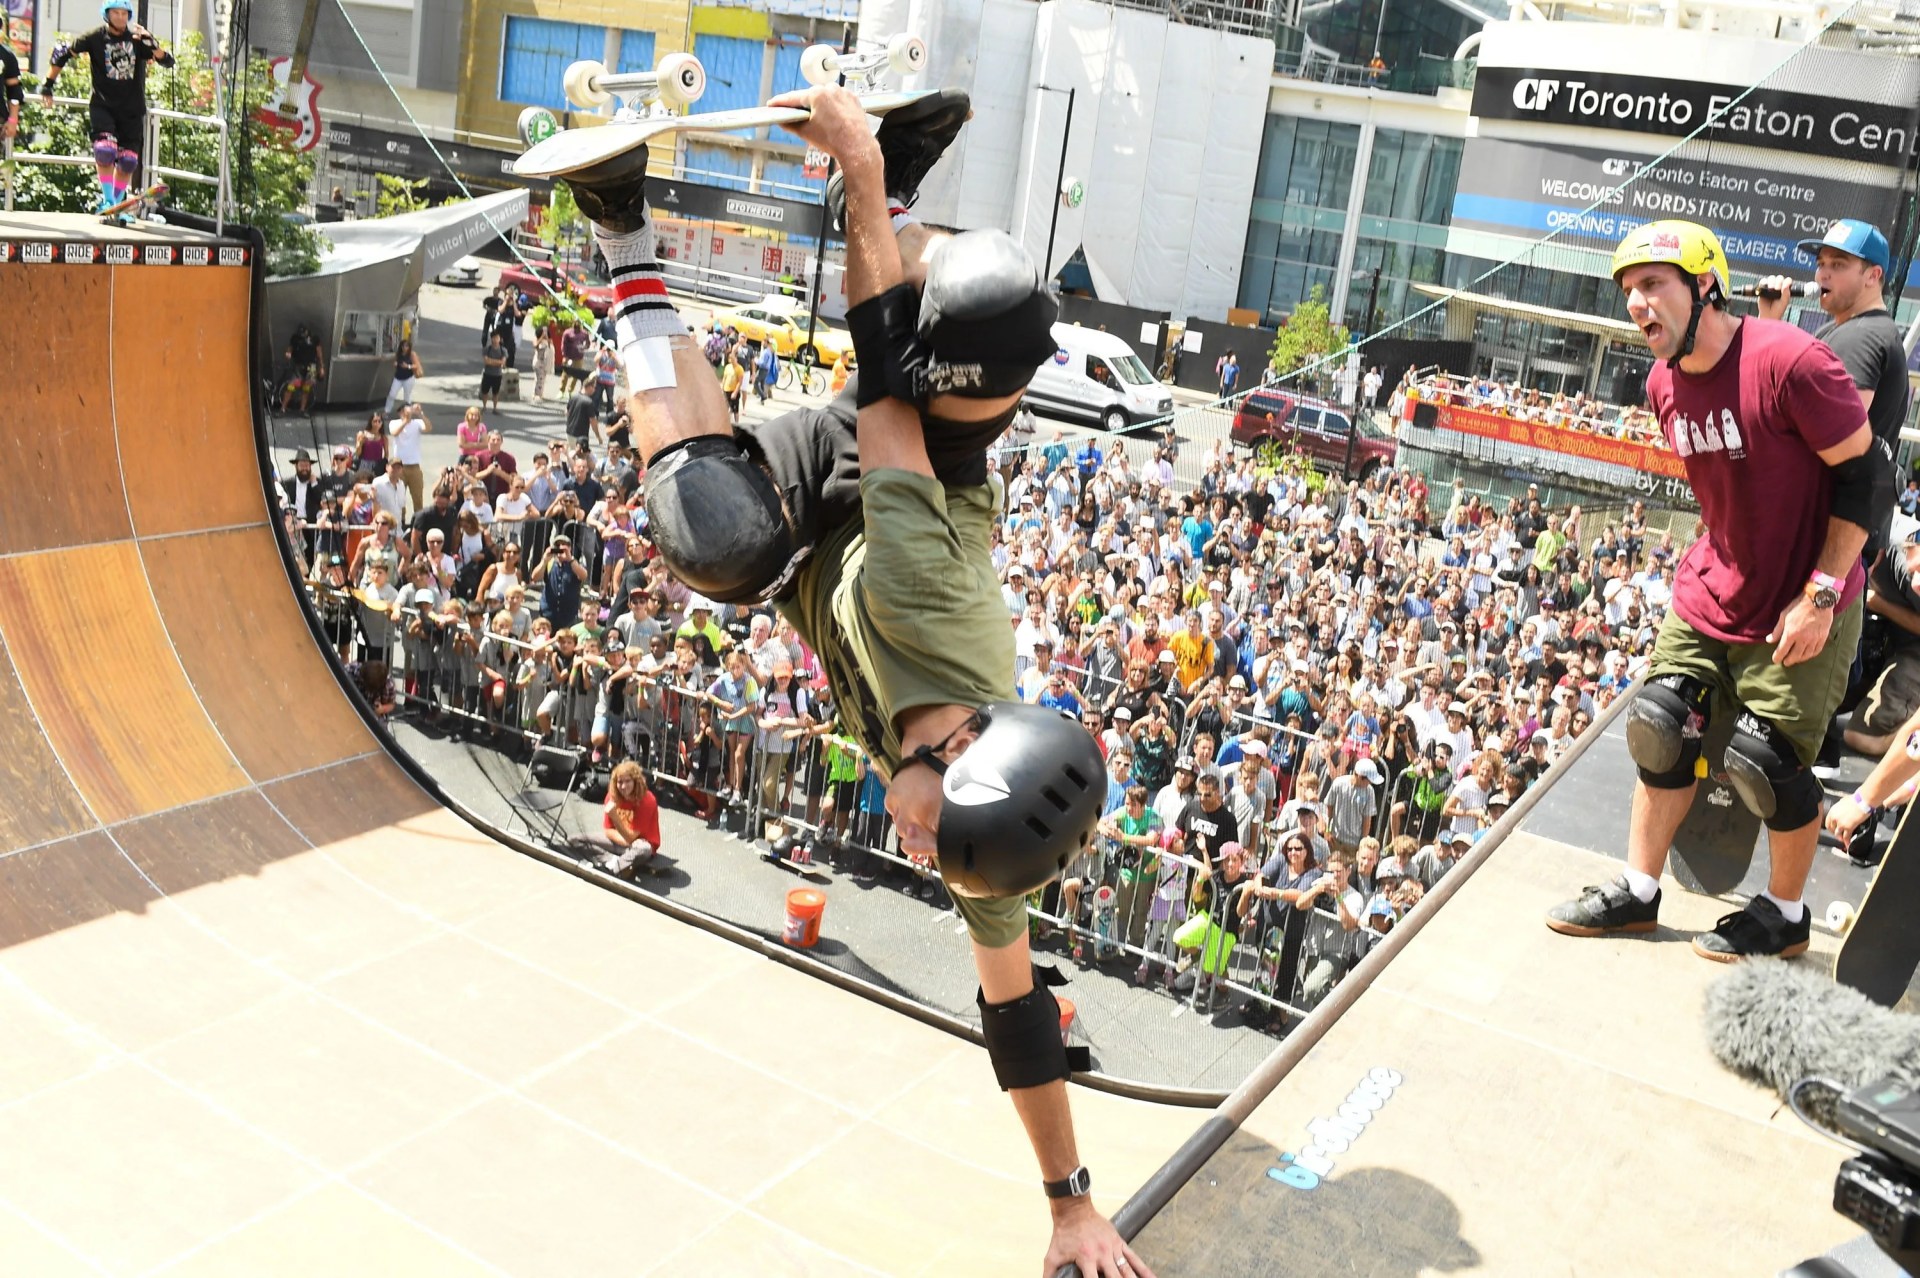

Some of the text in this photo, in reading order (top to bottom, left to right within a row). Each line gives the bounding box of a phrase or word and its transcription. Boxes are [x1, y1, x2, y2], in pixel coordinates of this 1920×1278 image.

[1512, 78, 1560, 111] CF
[1566, 81, 1693, 125] Toronto
[1706, 94, 1815, 140] Eaton
[1602, 158, 1815, 202] CF Toronto Eaton Centre
[1541, 178, 1625, 205] WELCOMES
[1632, 190, 1751, 223] NORDSTROM
[1762, 208, 1786, 228] TO
[427, 200, 526, 260] Visitor Information
[1546, 210, 1614, 235] OPENING
[1716, 233, 1787, 261] TEMBER
[24, 245, 49, 257] RIDE
[67, 246, 91, 258] RIDE
[108, 247, 130, 259] RIDE
[147, 248, 170, 260] RIDE
[184, 248, 206, 260] RIDE
[221, 249, 243, 261] RIDE
[1636, 470, 1660, 496] by
[1666, 477, 1696, 501] the
[1266, 1067, 1403, 1190] birdhouse
